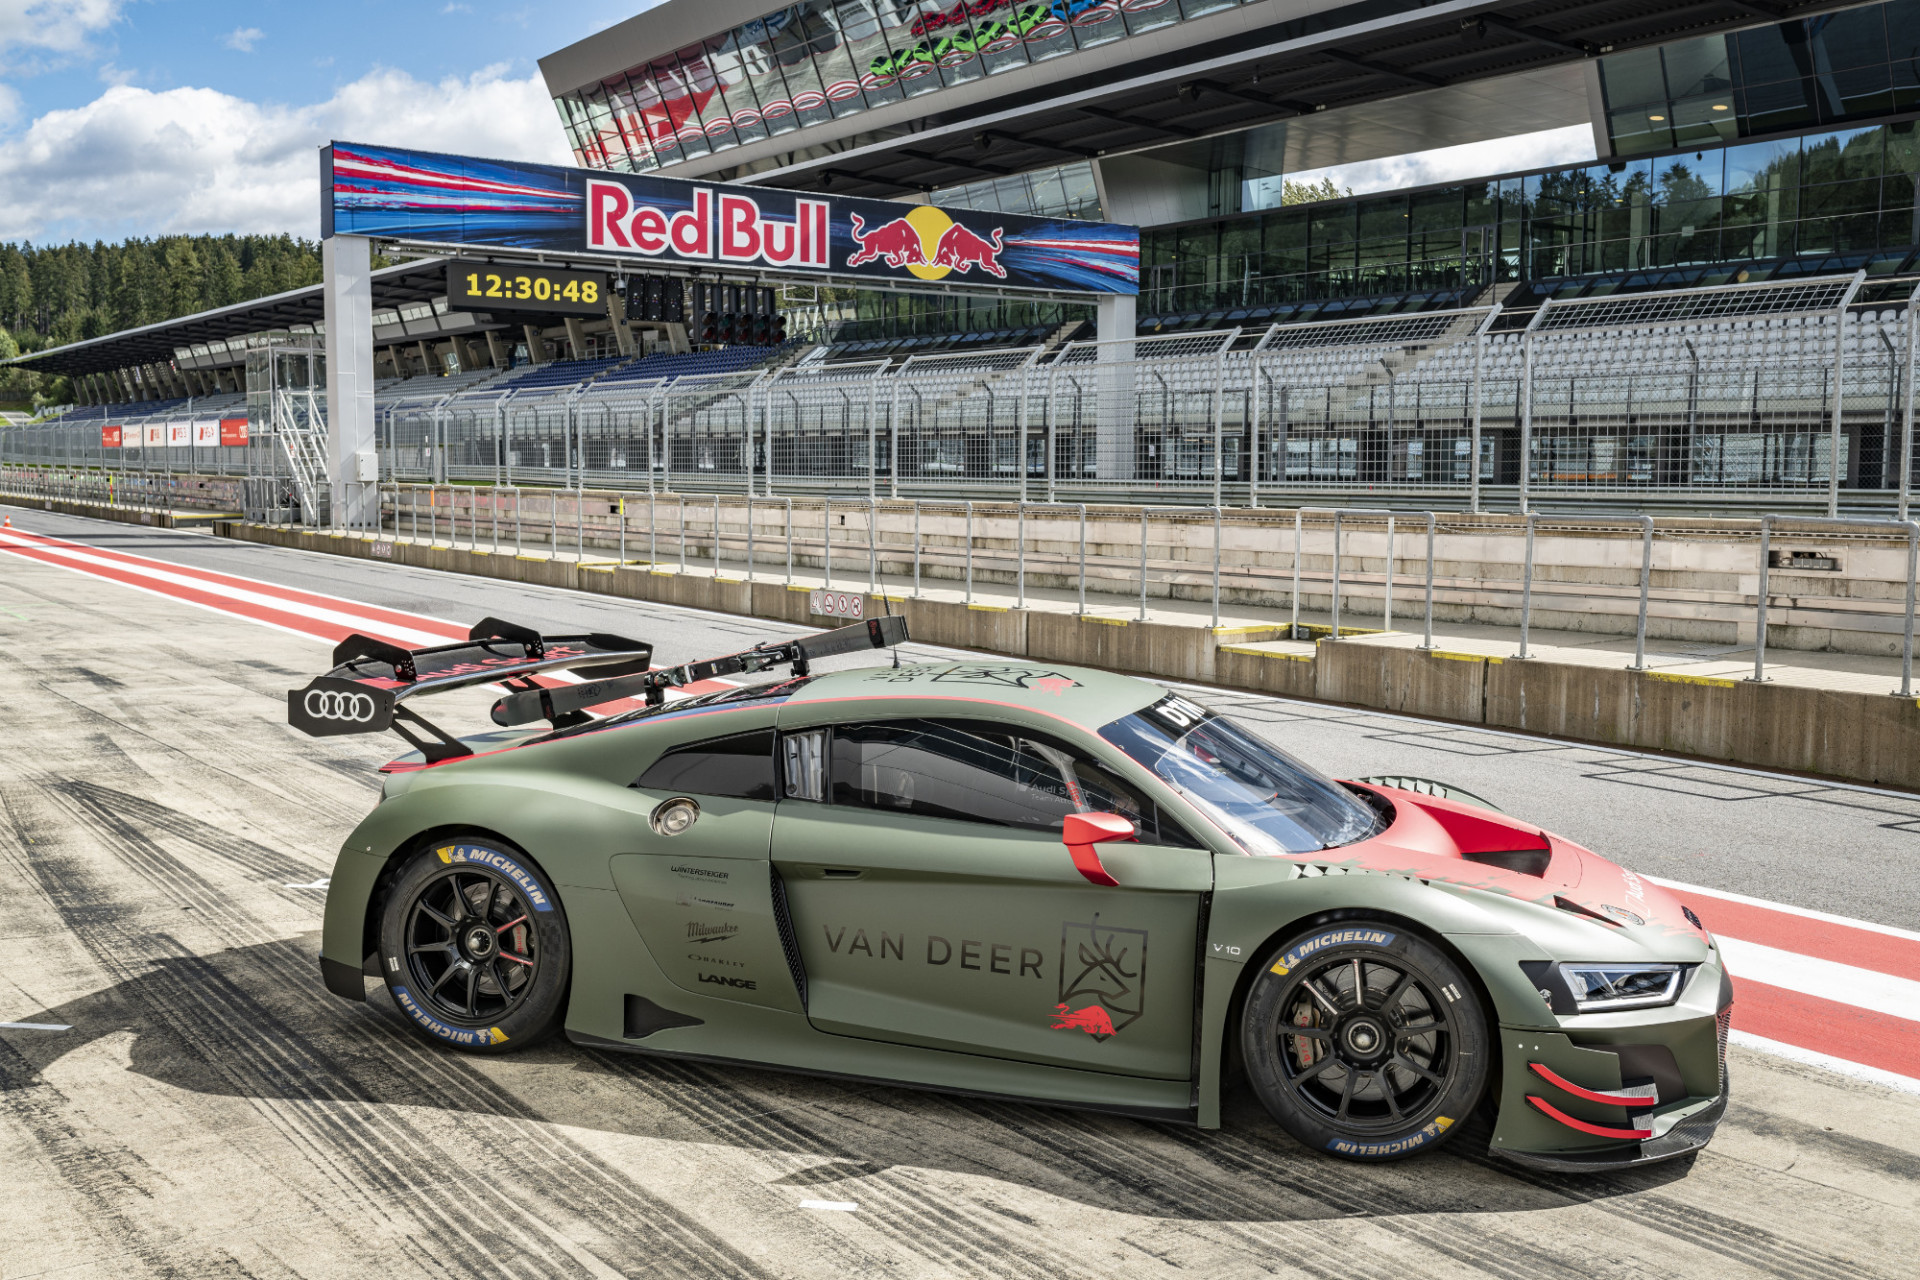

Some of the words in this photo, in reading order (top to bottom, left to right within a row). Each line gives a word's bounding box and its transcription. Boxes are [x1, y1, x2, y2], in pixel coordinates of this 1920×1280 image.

[587, 179, 713, 259] Red
[718, 193, 830, 268] Bull
[466, 273, 598, 303] 12:30:48
[1155, 696, 1207, 727] DTM
[469, 849, 546, 905] MICHELIN
[670, 863, 729, 880] WINTERSTEIGER
[685, 921, 739, 938] Milwaukee
[1299, 931, 1387, 957] MICHELIN
[823, 924, 904, 961] VAN
[926, 935, 1044, 980] DEER
[698, 972, 757, 991] LANGE
[398, 992, 473, 1044] MICHELIN
[1335, 1133, 1425, 1156] MICHELIN
